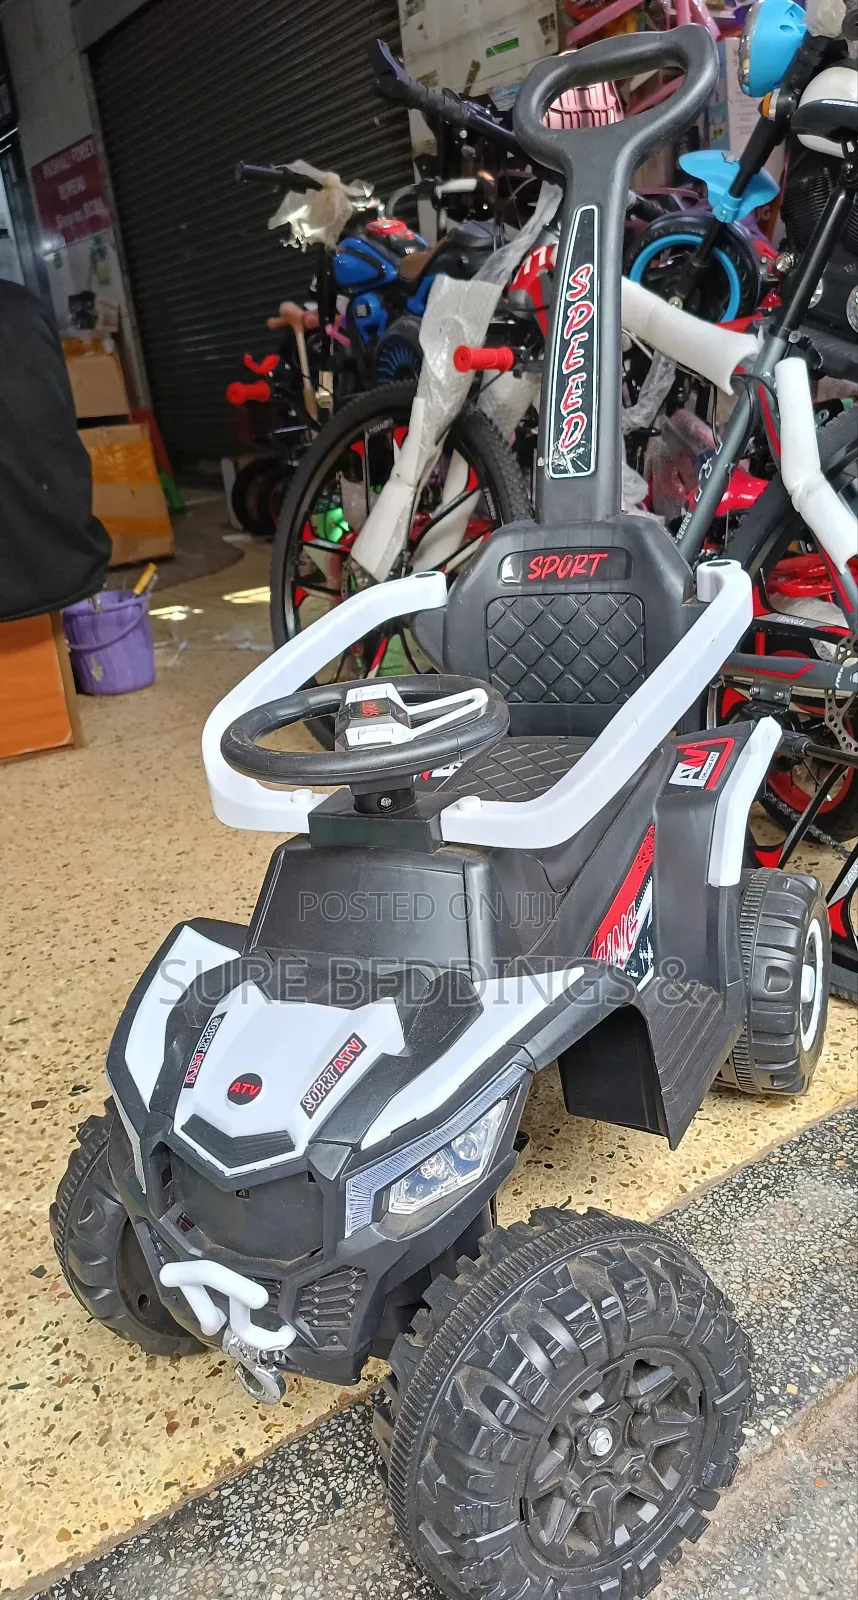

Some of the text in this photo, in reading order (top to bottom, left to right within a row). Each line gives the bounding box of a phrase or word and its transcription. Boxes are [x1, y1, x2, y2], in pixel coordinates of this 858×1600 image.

[559, 264, 594, 450] SPEED
[527, 553, 608, 580] SPORT
[184, 1052, 205, 1085] ATV
[301, 1036, 364, 1113] SOPRT ATV
[230, 1081, 261, 1097] ATV
